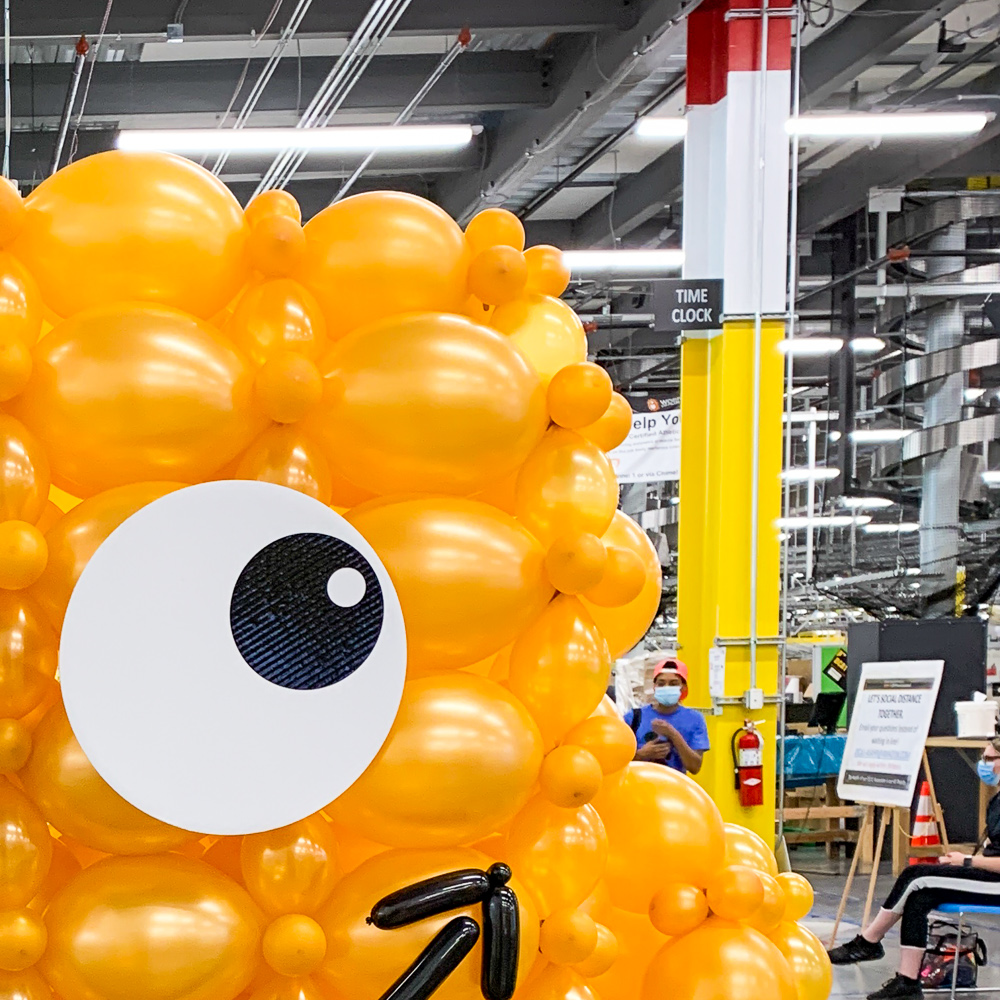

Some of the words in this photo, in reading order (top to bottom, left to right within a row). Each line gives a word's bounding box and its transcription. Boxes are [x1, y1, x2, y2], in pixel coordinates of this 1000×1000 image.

[675, 288, 708, 303] TIME
[671, 307, 713, 323] CLOCK
[633, 416, 657, 431] elp
[661, 414, 680, 425] Yo
[880, 694, 897, 703] SOCIAL
[898, 694, 923, 704] DISTANCE
